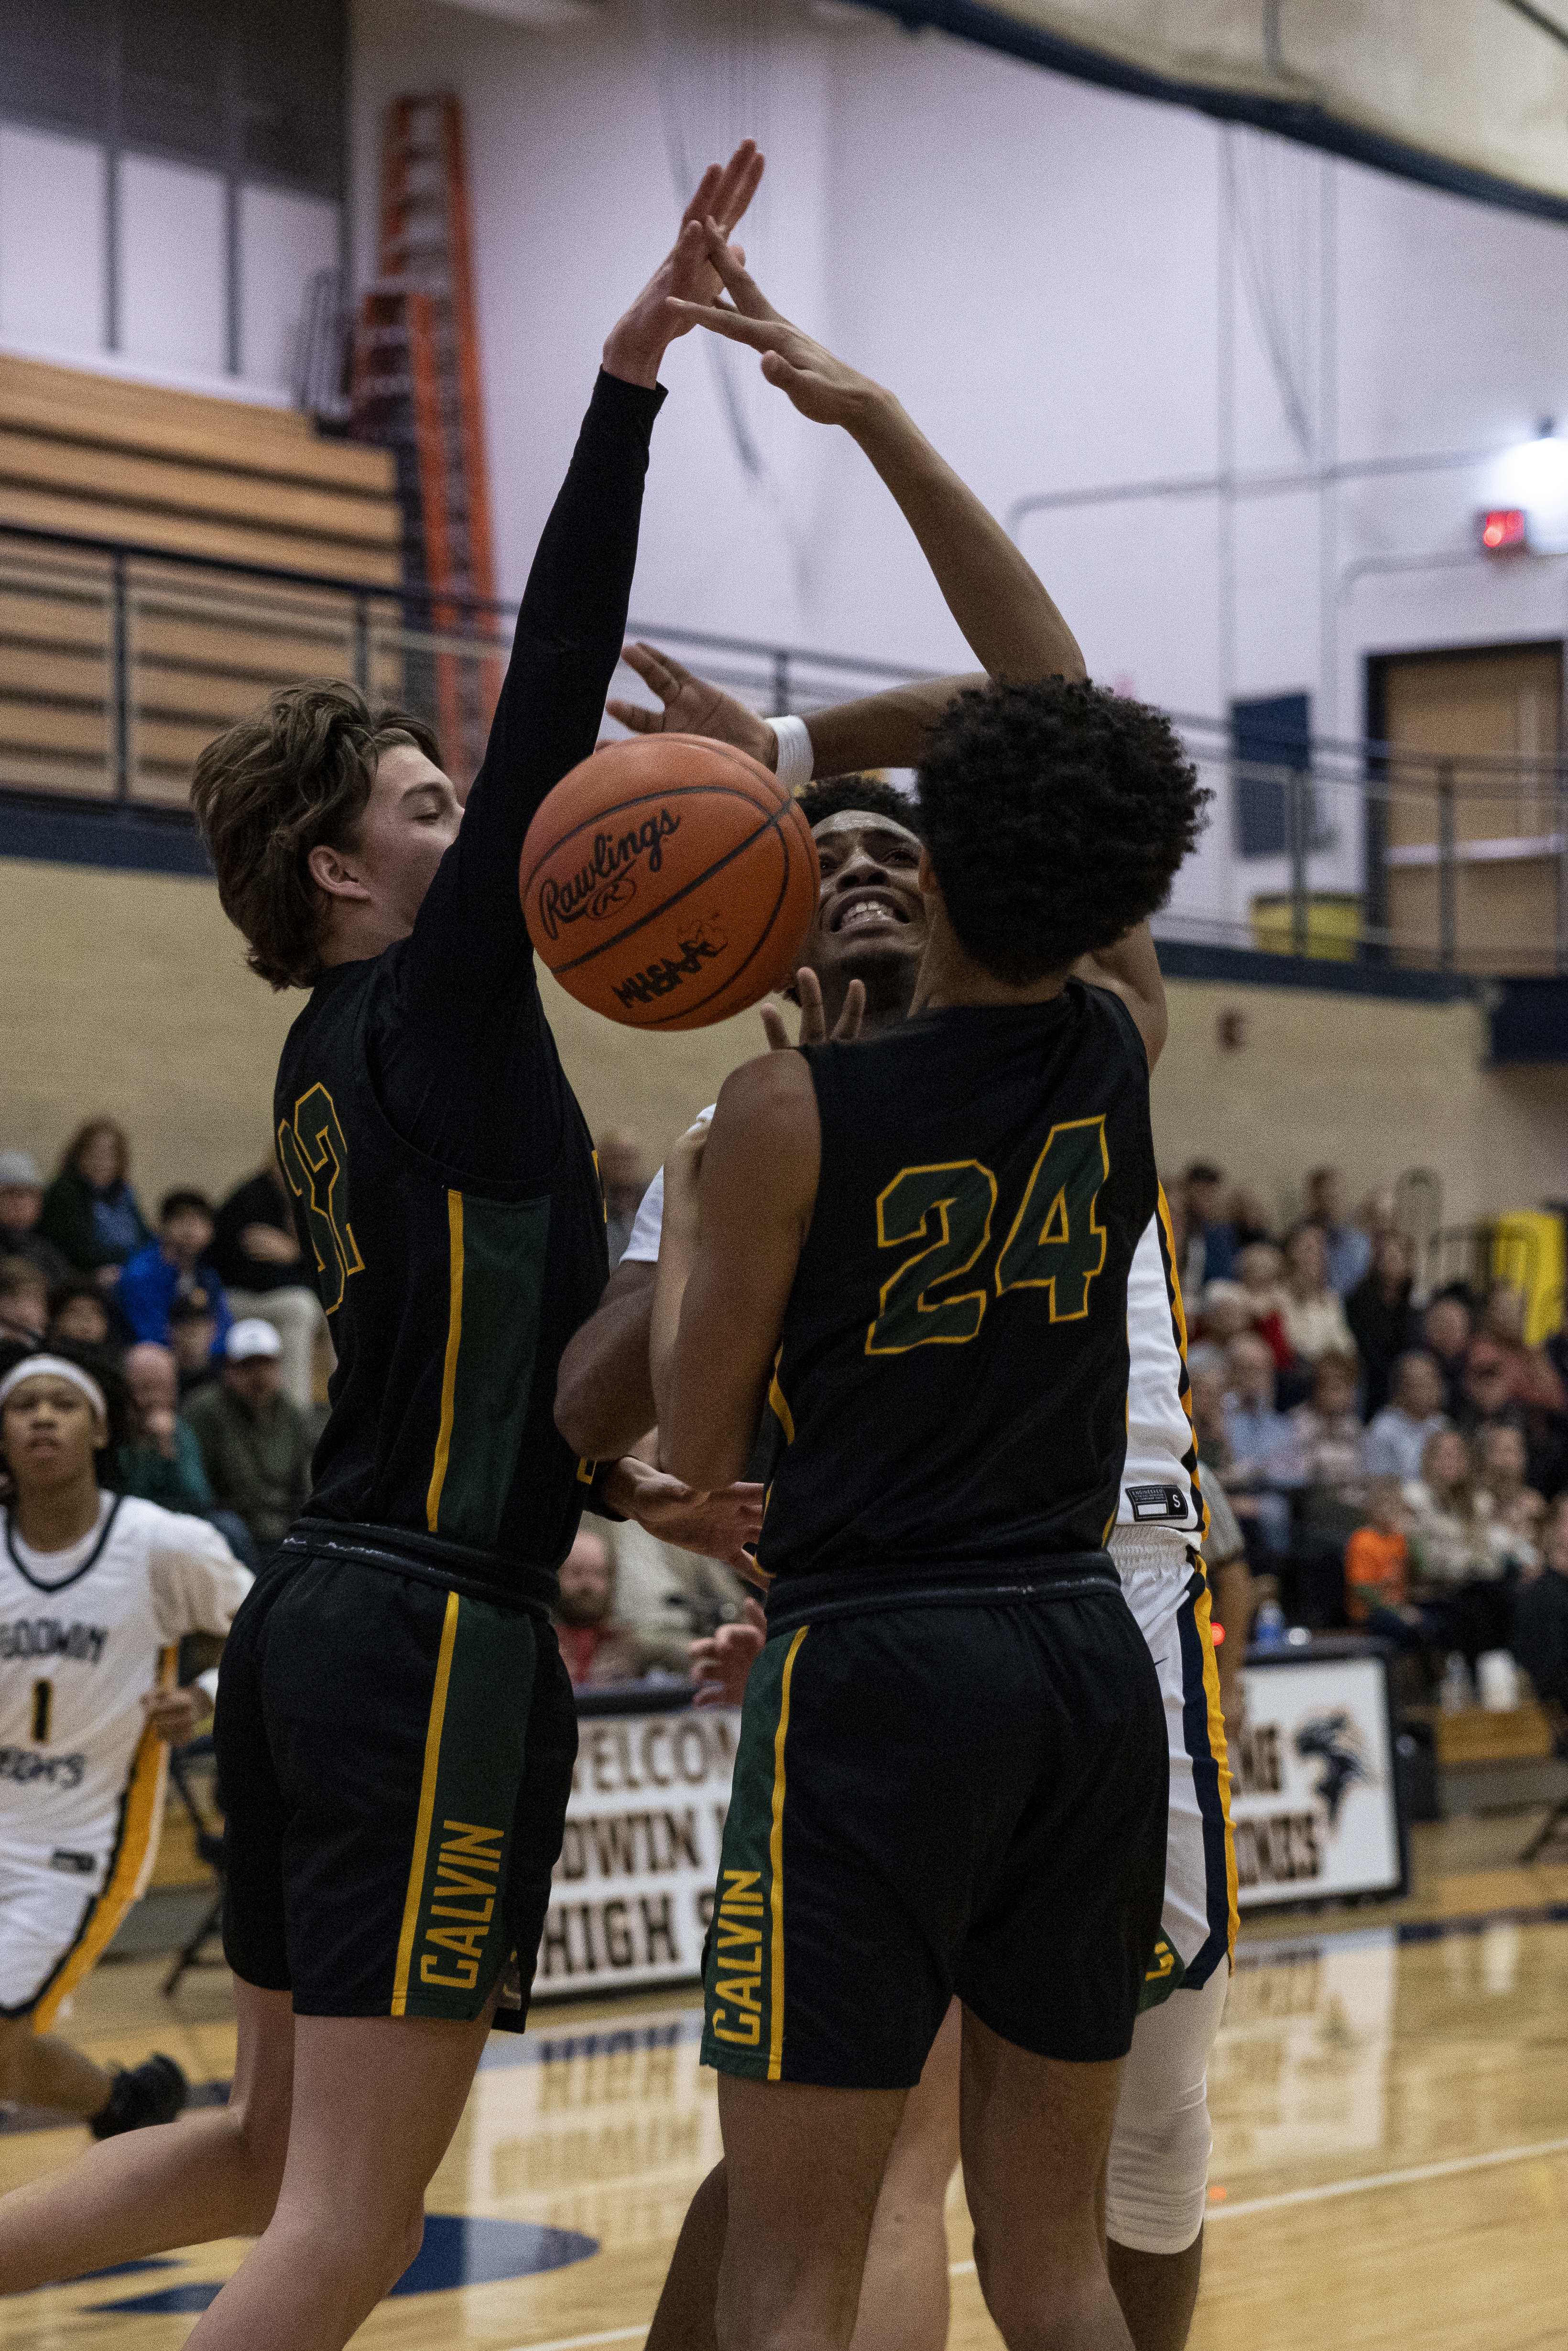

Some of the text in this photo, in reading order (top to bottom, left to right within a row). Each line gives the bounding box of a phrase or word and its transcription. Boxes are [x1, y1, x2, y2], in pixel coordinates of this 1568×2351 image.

[540, 809, 681, 940] Rawlings
[865, 1113, 1110, 1356] 24
[1173, 1494, 1180, 1508] S
[31, 1677, 55, 1746] 1
[420, 1820, 504, 1989] CALVIN
[542, 1894, 680, 1977] HIGH
[713, 1870, 764, 2045] CALVIN
